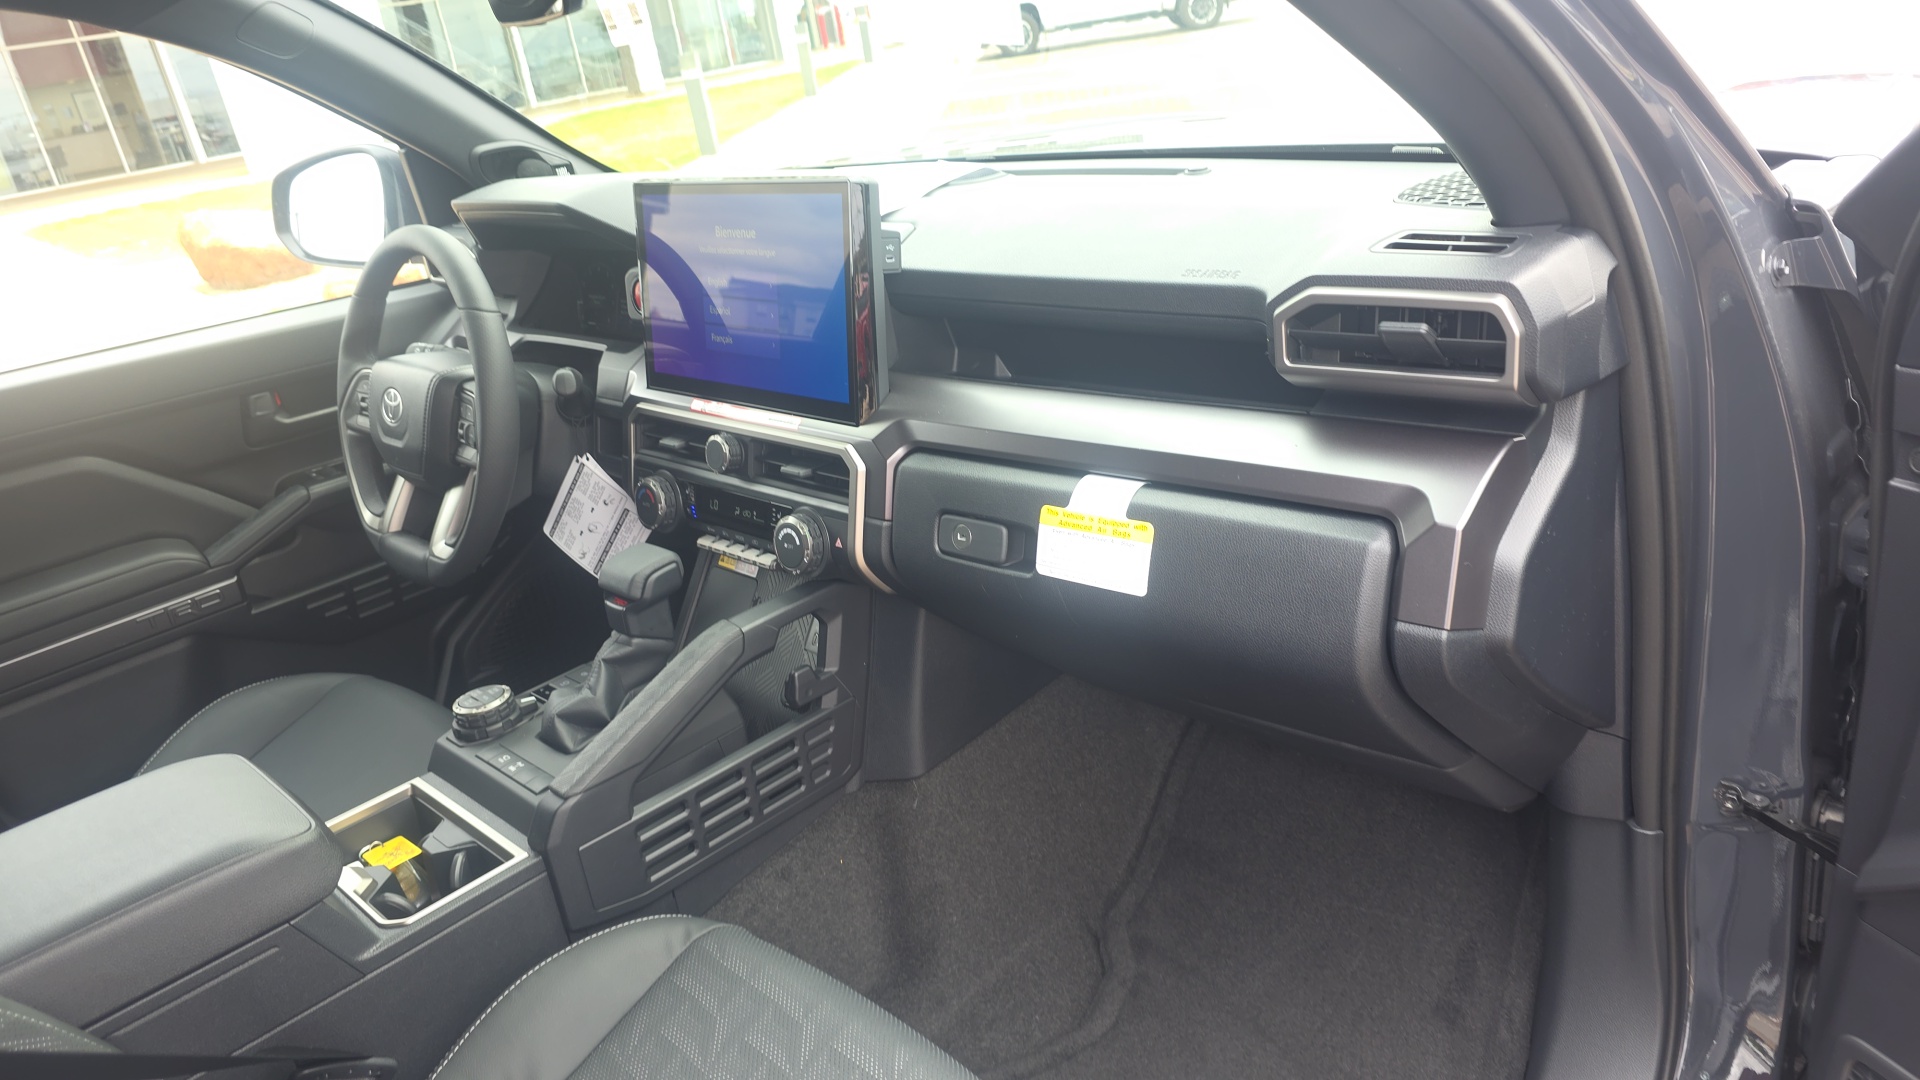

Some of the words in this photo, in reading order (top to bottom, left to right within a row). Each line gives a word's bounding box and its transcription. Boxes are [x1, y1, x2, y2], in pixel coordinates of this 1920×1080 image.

[714, 225, 757, 239] Bienvenue
[710, 304, 731, 316] Español
[711, 332, 733, 344] Français
[1046, 507, 1059, 517] This
[1133, 523, 1149, 532] with
[1058, 519, 1093, 532] Advanced
[1112, 528, 1131, 539] Bags
[136, 589, 224, 630] TRD
